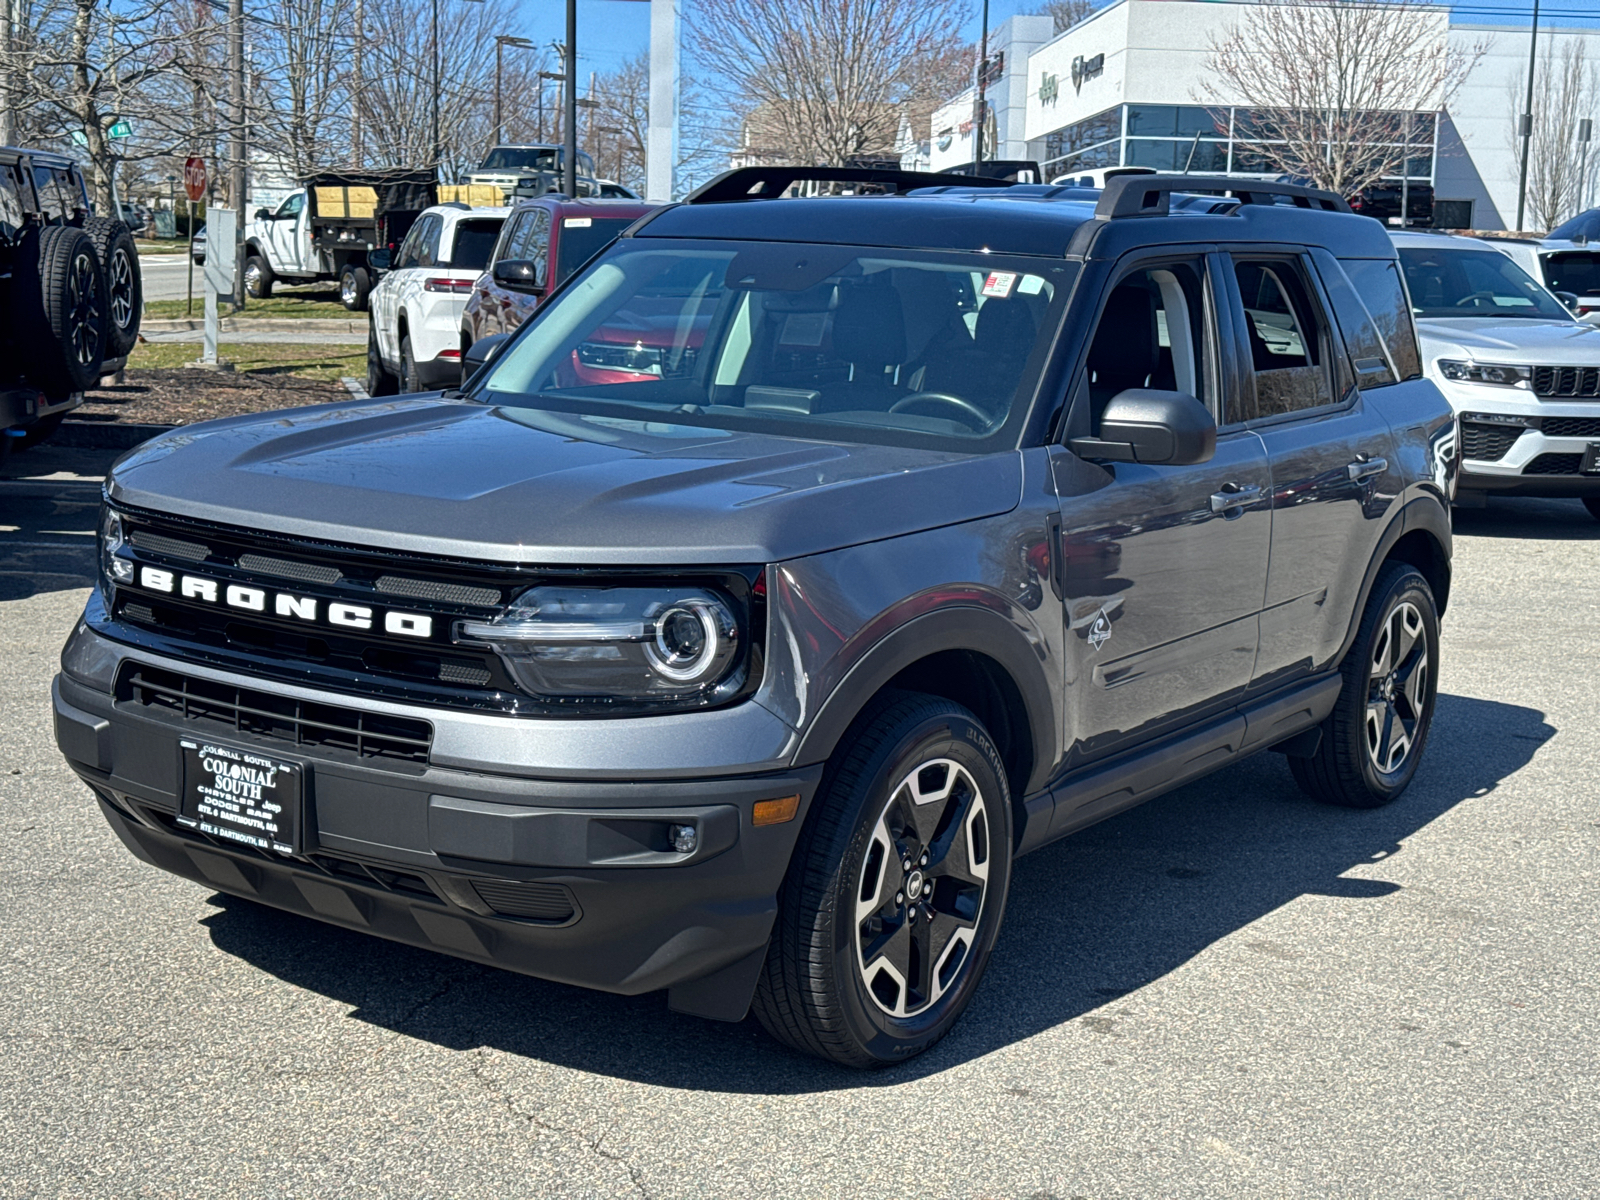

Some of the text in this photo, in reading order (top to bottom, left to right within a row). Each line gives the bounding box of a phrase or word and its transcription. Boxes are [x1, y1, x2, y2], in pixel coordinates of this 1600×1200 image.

[185, 166, 205, 187] STOP
[141, 566, 432, 638] BRONCO
[203, 745, 241, 760] COLONIAL
[243, 755, 272, 768] SOUTH
[966, 727, 1010, 806] BLACKHAWK
[203, 757, 276, 800] COLONIAL SOUTH
[197, 785, 282, 814] CHRYSLER Jeep
[204, 796, 273, 820] DODGE RAM
[213, 808, 219, 817] 6
[266, 822, 278, 833] MA
[258, 839, 269, 849] MA
